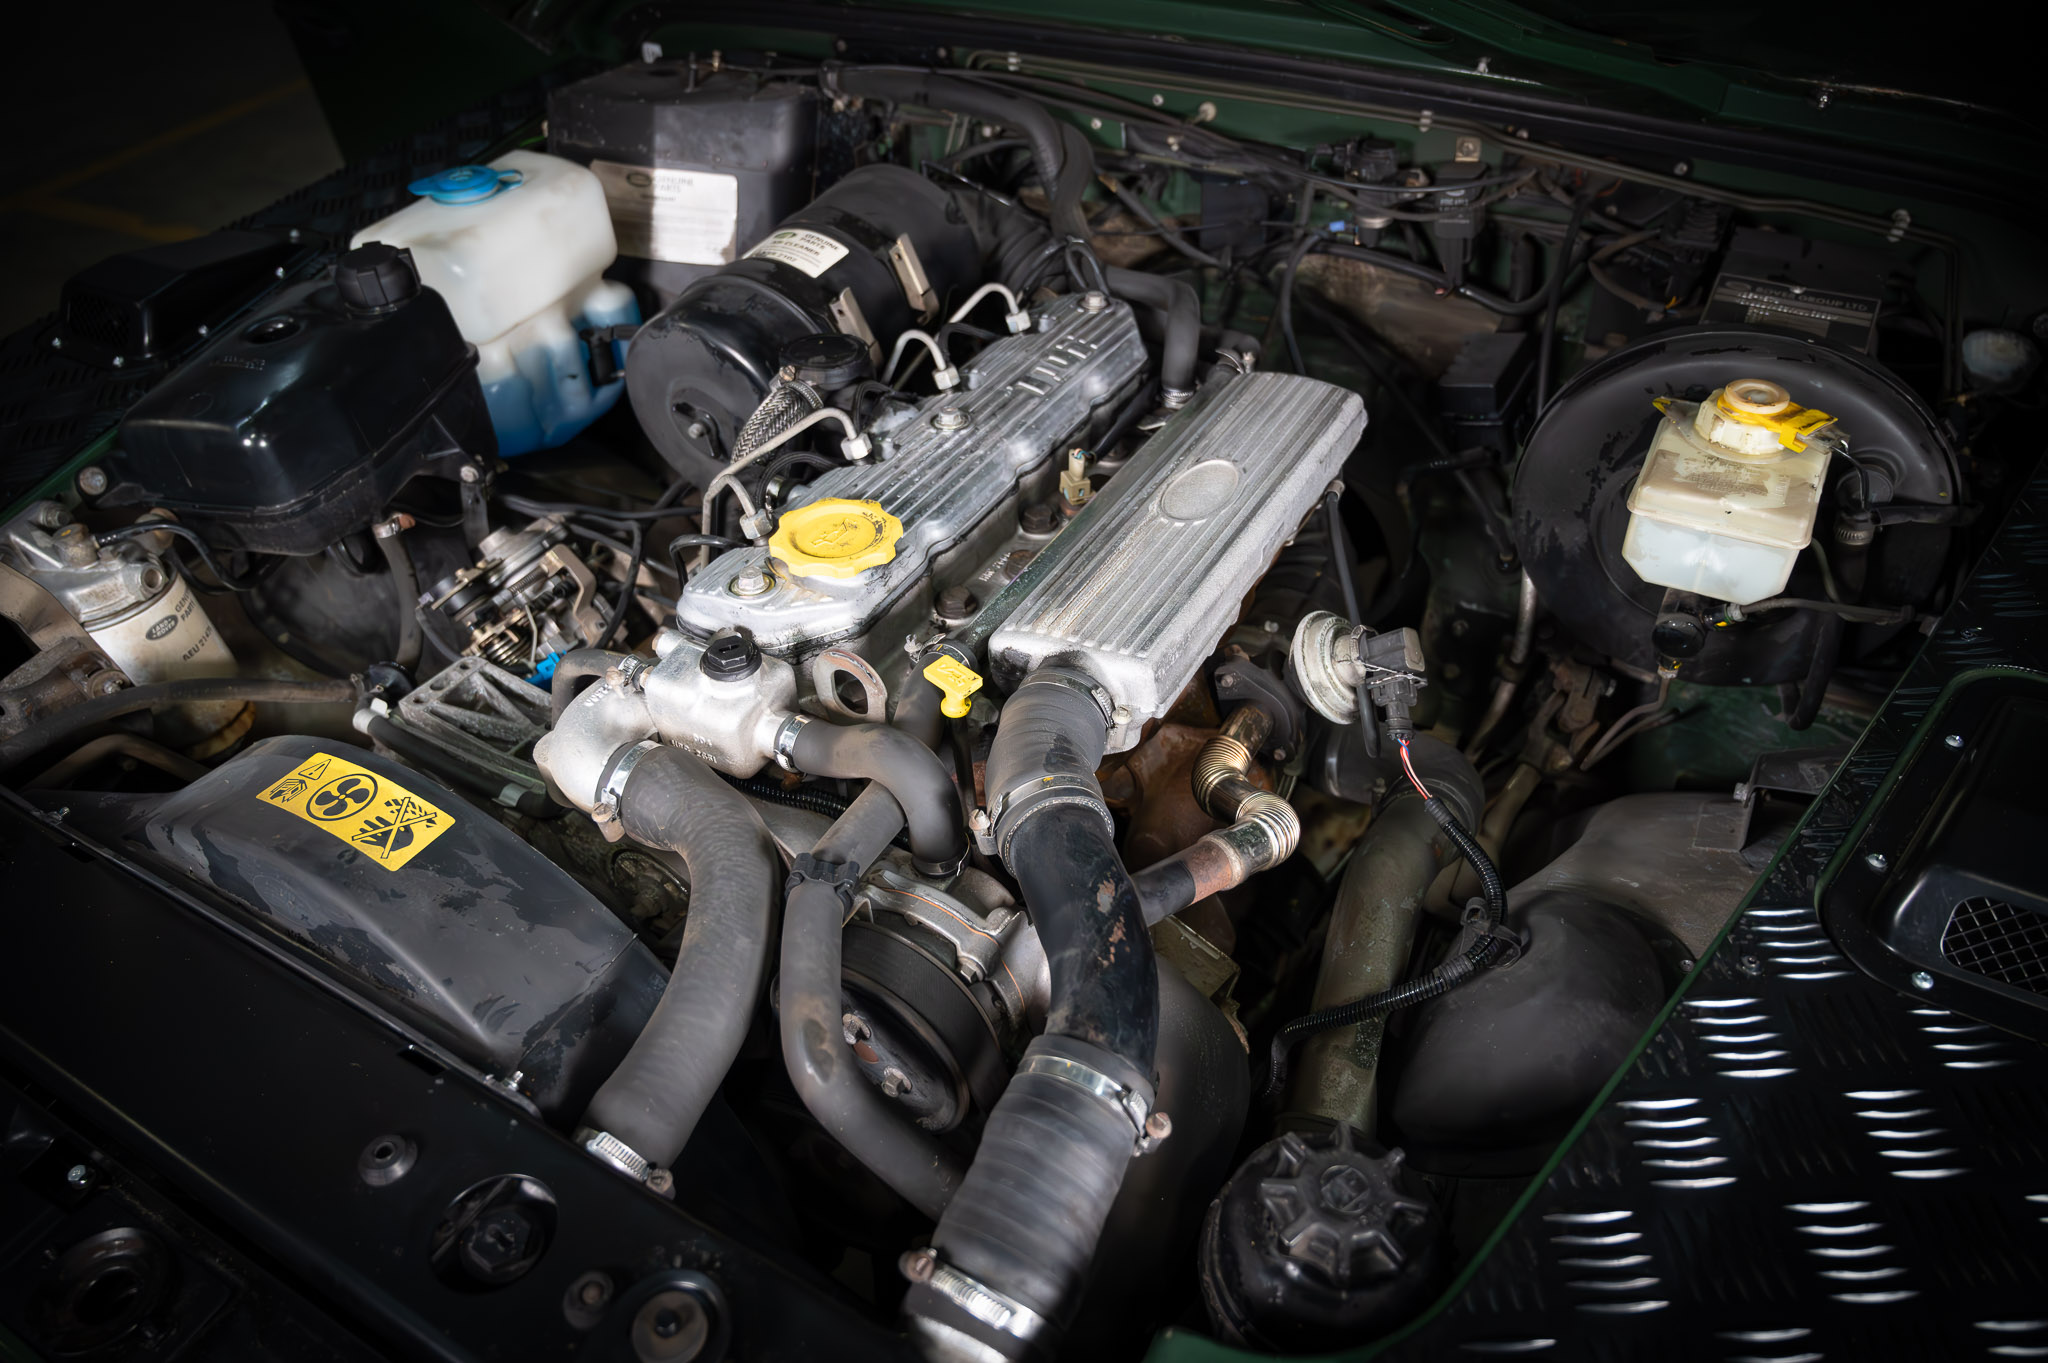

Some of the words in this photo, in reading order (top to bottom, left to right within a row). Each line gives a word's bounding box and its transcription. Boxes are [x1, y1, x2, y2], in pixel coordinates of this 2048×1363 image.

[784, 241, 820, 256] CLEANER
[799, 237, 825, 250] PARTS
[804, 233, 839, 251] GENUINE
[1755, 286, 1796, 300] ROVER
[1798, 295, 1844, 307] GROUP
[1845, 301, 1868, 311] LTD
[151, 619, 170, 634] LAND
[156, 621, 176, 638] ROVER
[182, 645, 200, 662] AEU
